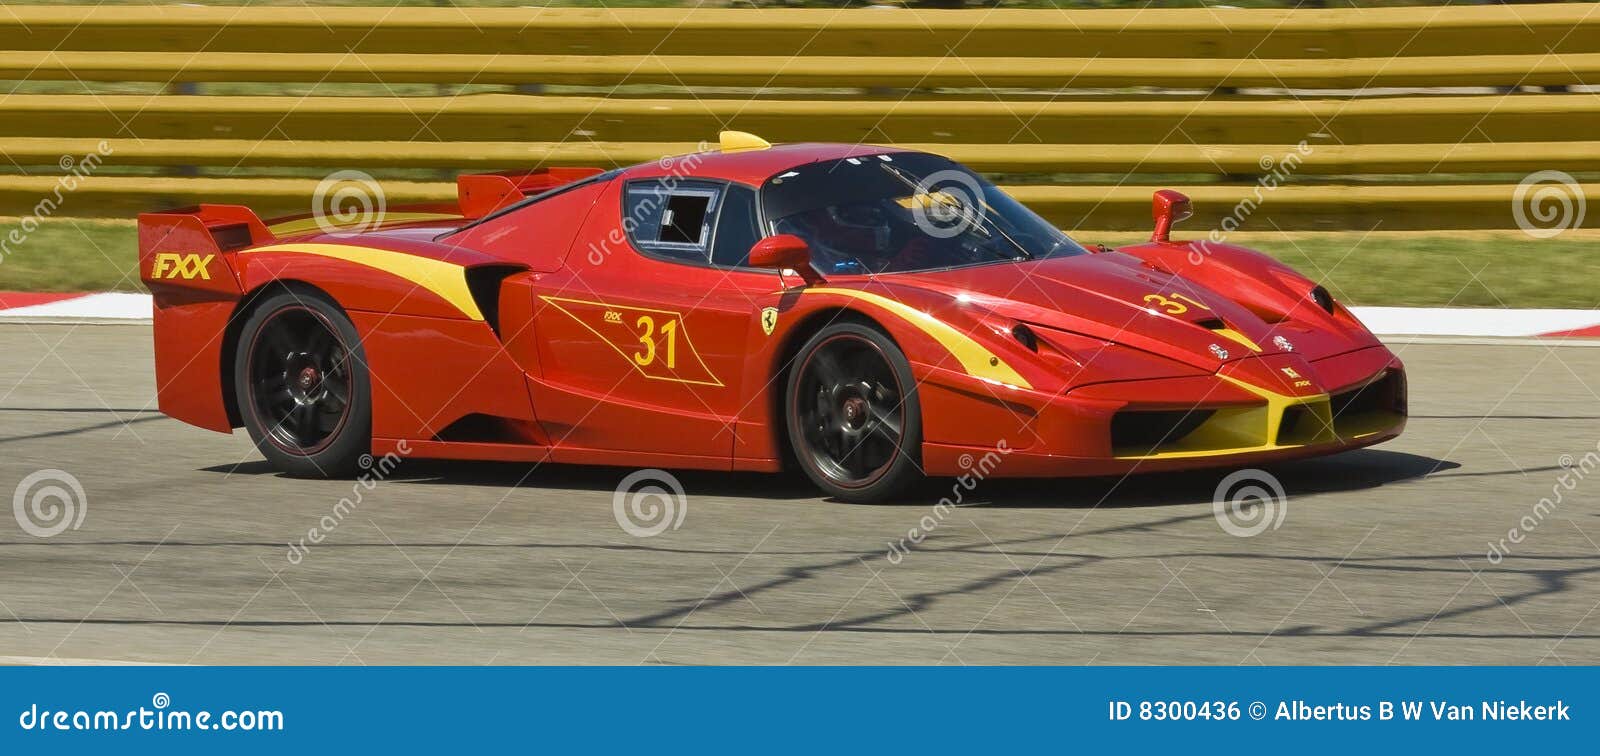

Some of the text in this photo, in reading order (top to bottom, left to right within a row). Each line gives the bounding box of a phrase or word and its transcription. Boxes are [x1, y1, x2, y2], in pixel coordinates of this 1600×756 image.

[152, 253, 215, 280] FXX
[604, 311, 623, 321] FXX
[1143, 292, 1211, 315] 31
[634, 315, 676, 369] 31
